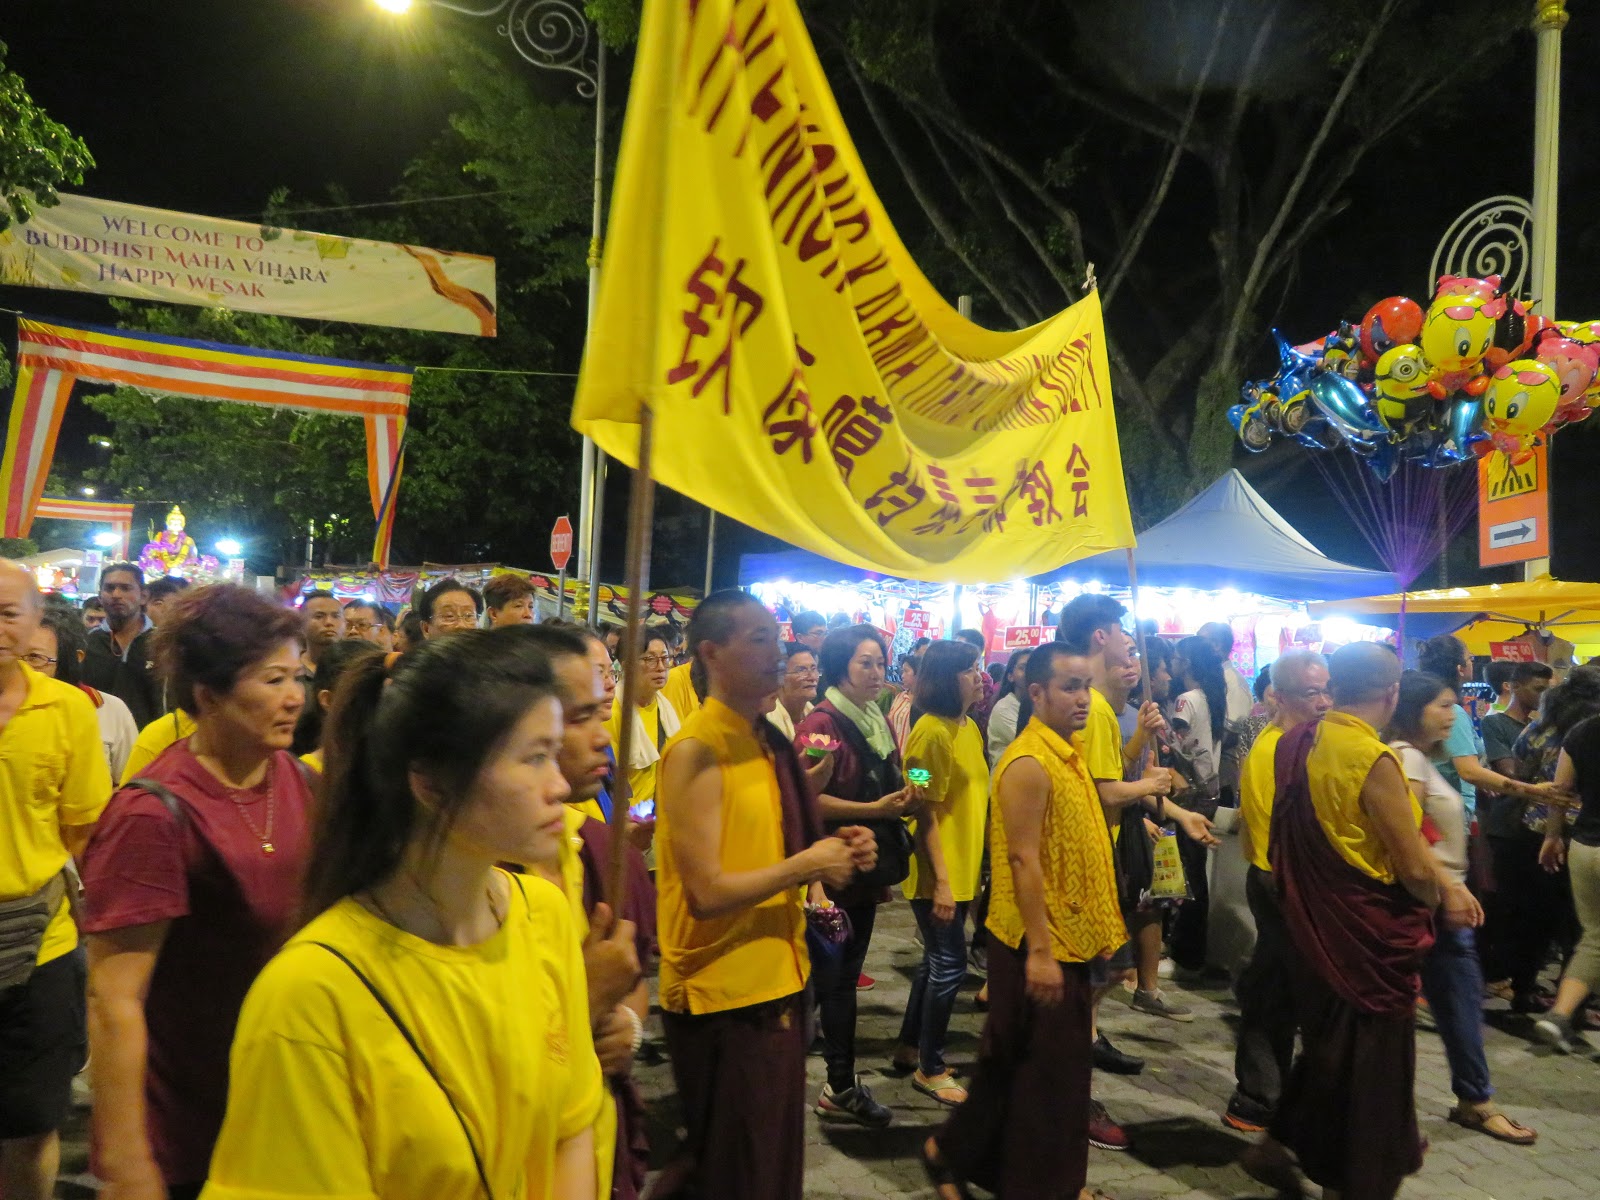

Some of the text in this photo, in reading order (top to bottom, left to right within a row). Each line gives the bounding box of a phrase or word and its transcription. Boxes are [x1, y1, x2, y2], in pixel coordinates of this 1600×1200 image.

[102, 215, 264, 252] WELCOME TO
[26, 228, 328, 284] BUDDHIST MAHA VIHARA
[99, 262, 266, 298] HAPPY WESAK
